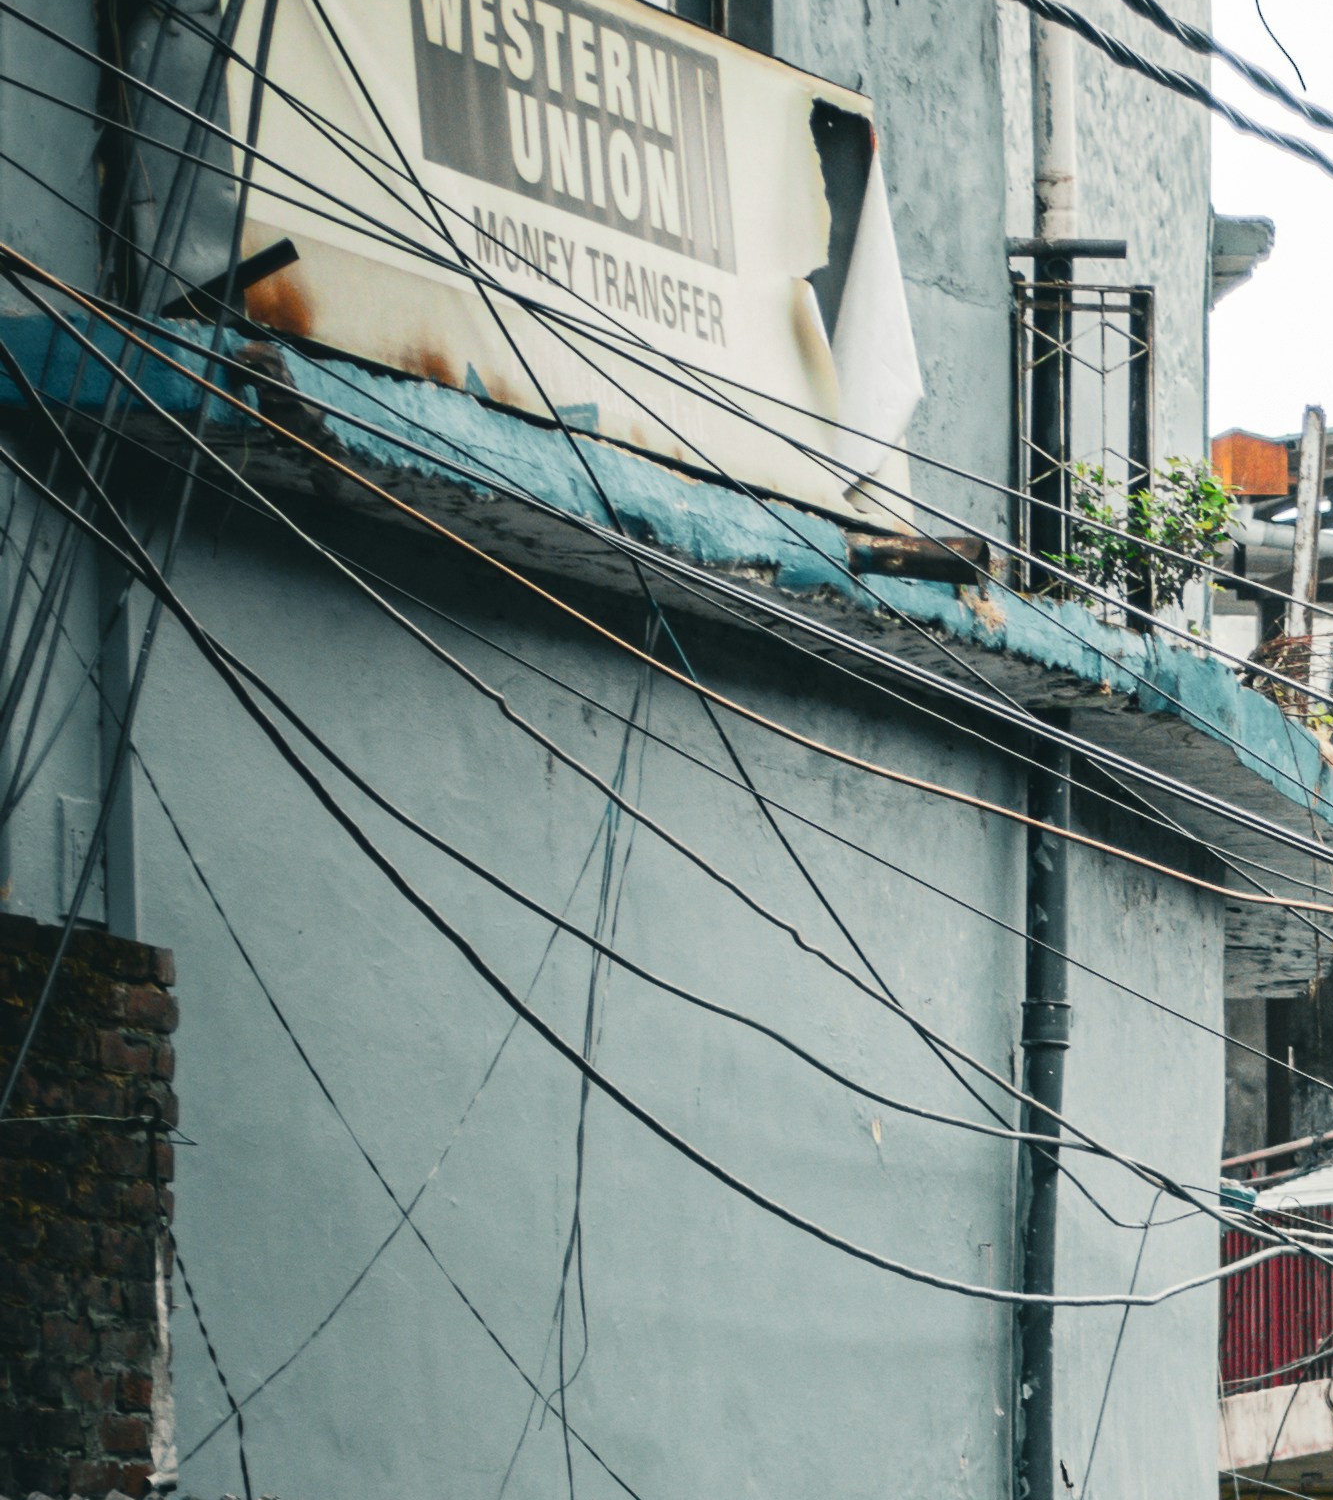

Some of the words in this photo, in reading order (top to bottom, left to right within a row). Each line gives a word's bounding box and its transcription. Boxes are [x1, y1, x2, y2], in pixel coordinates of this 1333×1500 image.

[507, 87, 683, 238] UNION
[473, 206, 577, 290] MONEY
[585, 247, 727, 348] TRANSFER
